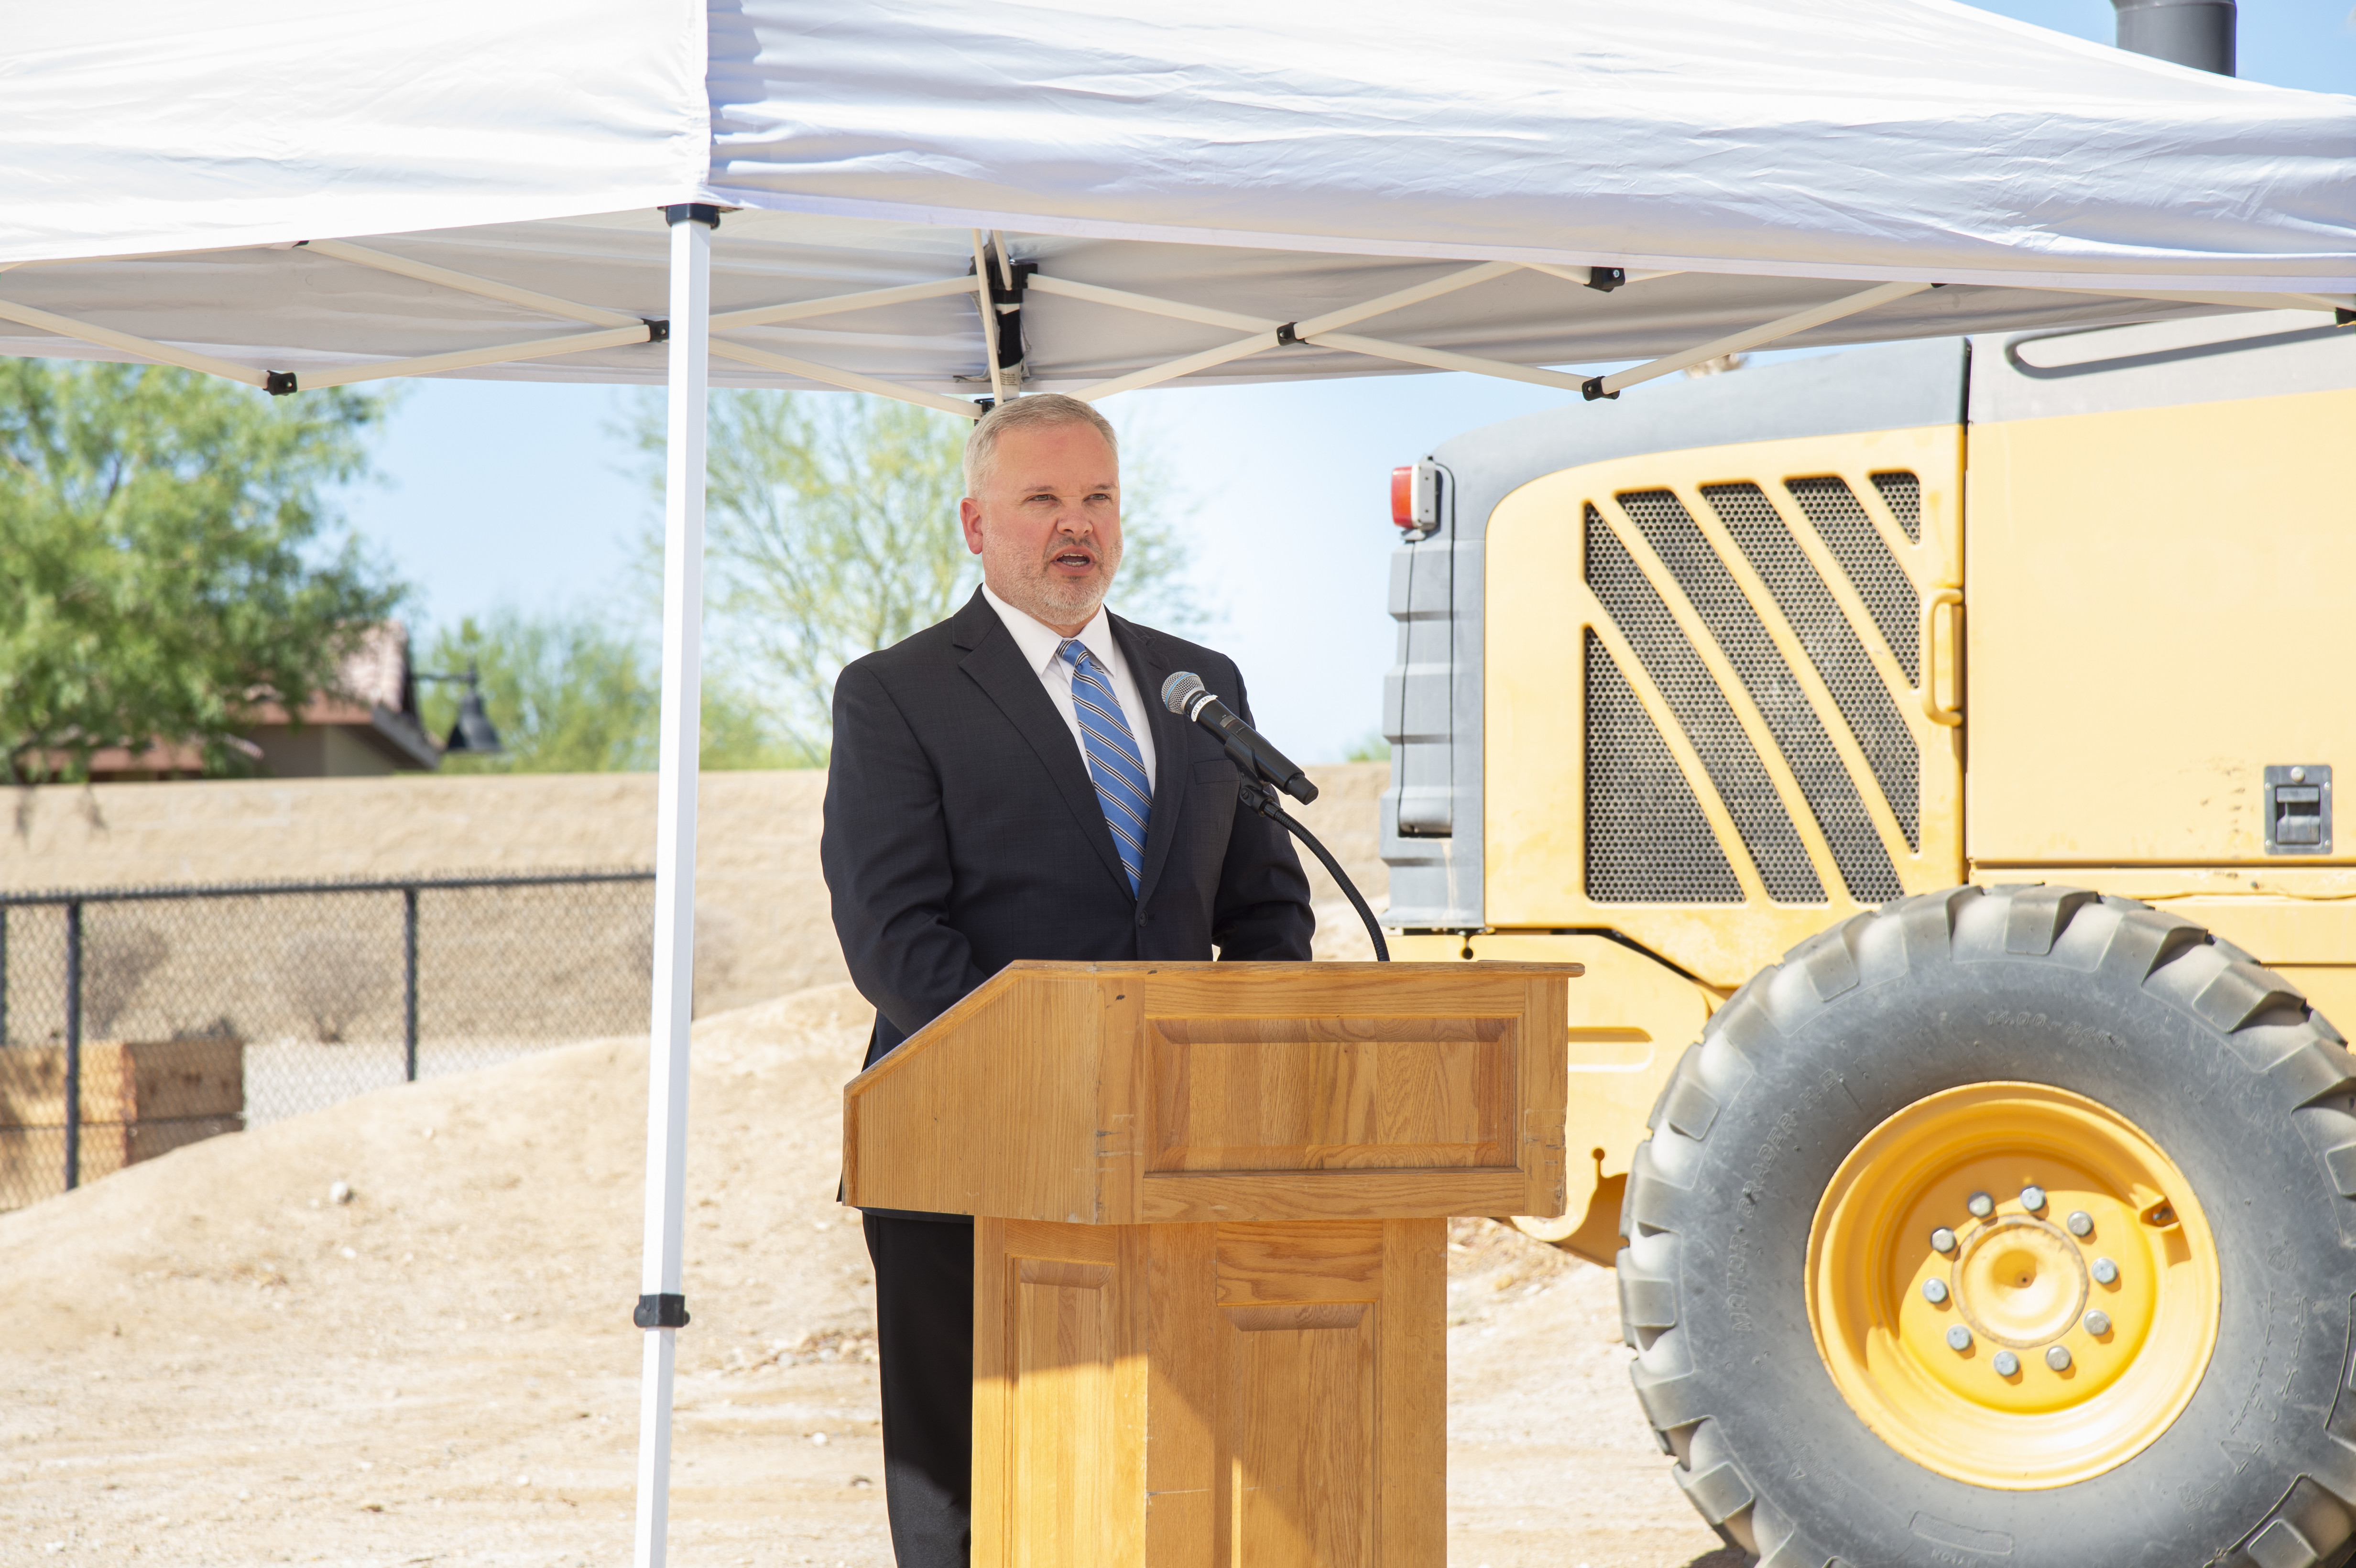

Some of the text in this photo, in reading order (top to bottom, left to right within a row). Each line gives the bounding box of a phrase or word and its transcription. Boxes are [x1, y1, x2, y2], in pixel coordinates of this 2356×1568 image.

[1189, 693, 1202, 706] SHURE
[1193, 708, 1199, 716] AR
[1737, 1112, 1798, 1219] GRADER
[1727, 1234, 1752, 1332] MOTOR
